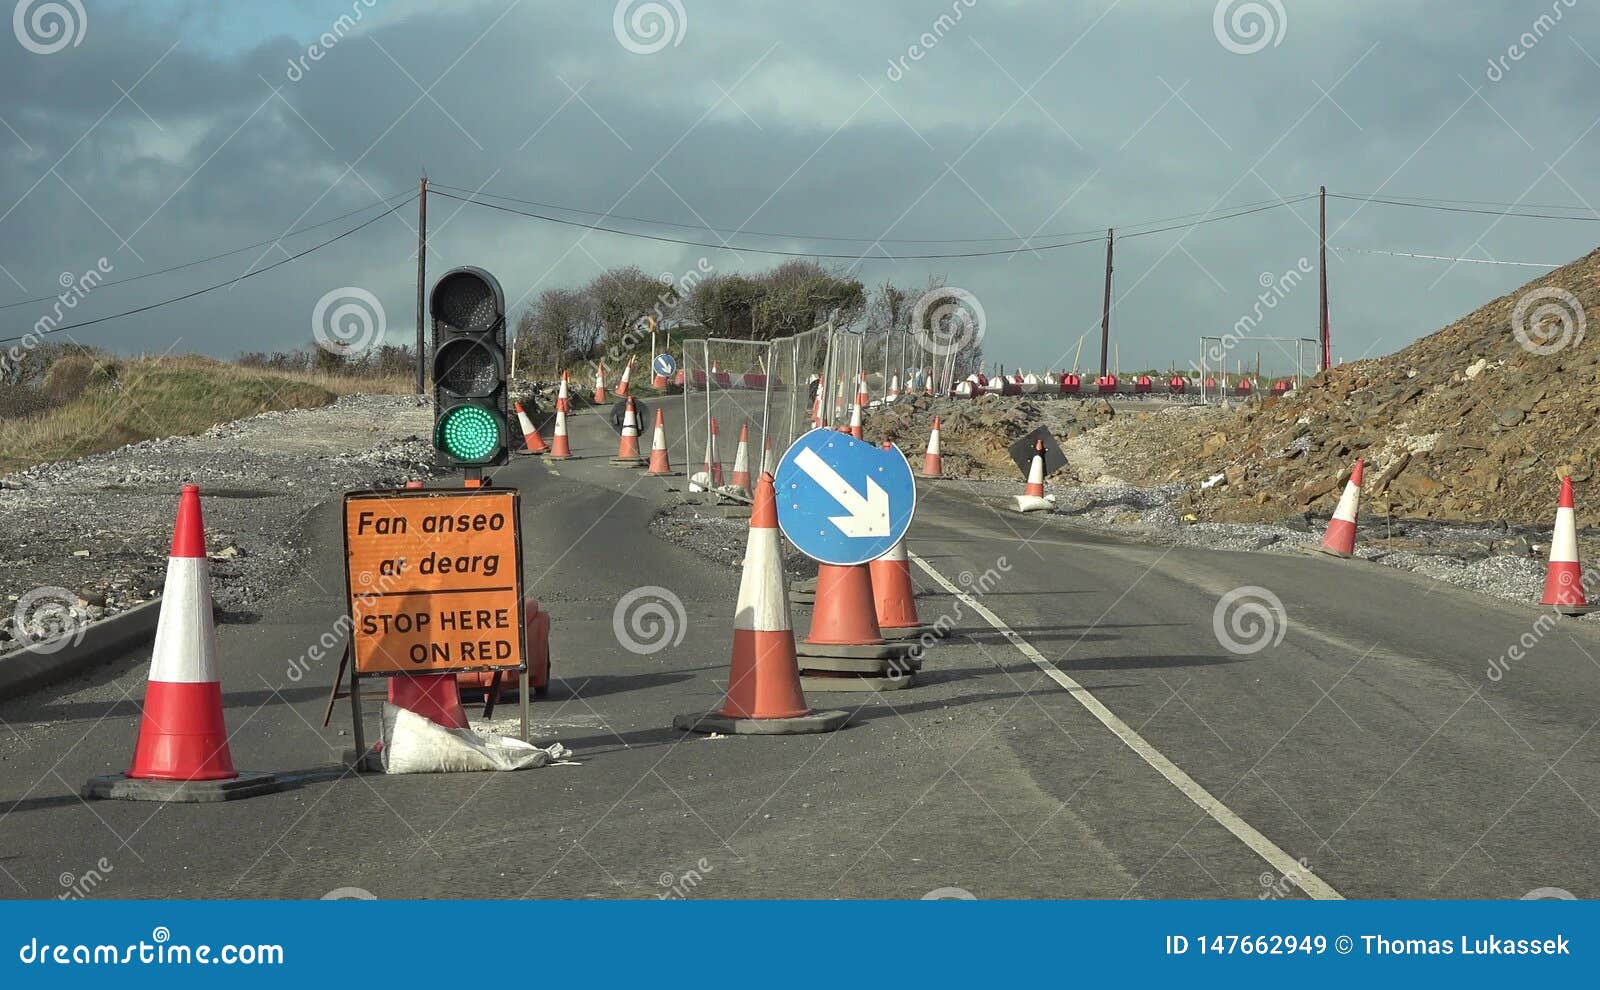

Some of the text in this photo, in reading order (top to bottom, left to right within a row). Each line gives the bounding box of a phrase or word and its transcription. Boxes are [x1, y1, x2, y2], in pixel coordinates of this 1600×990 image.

[357, 511, 505, 536] Fan anseo
[379, 551, 500, 577] ar dearg
[362, 608, 510, 635] STOP HERE
[409, 640, 512, 664] ON RED
